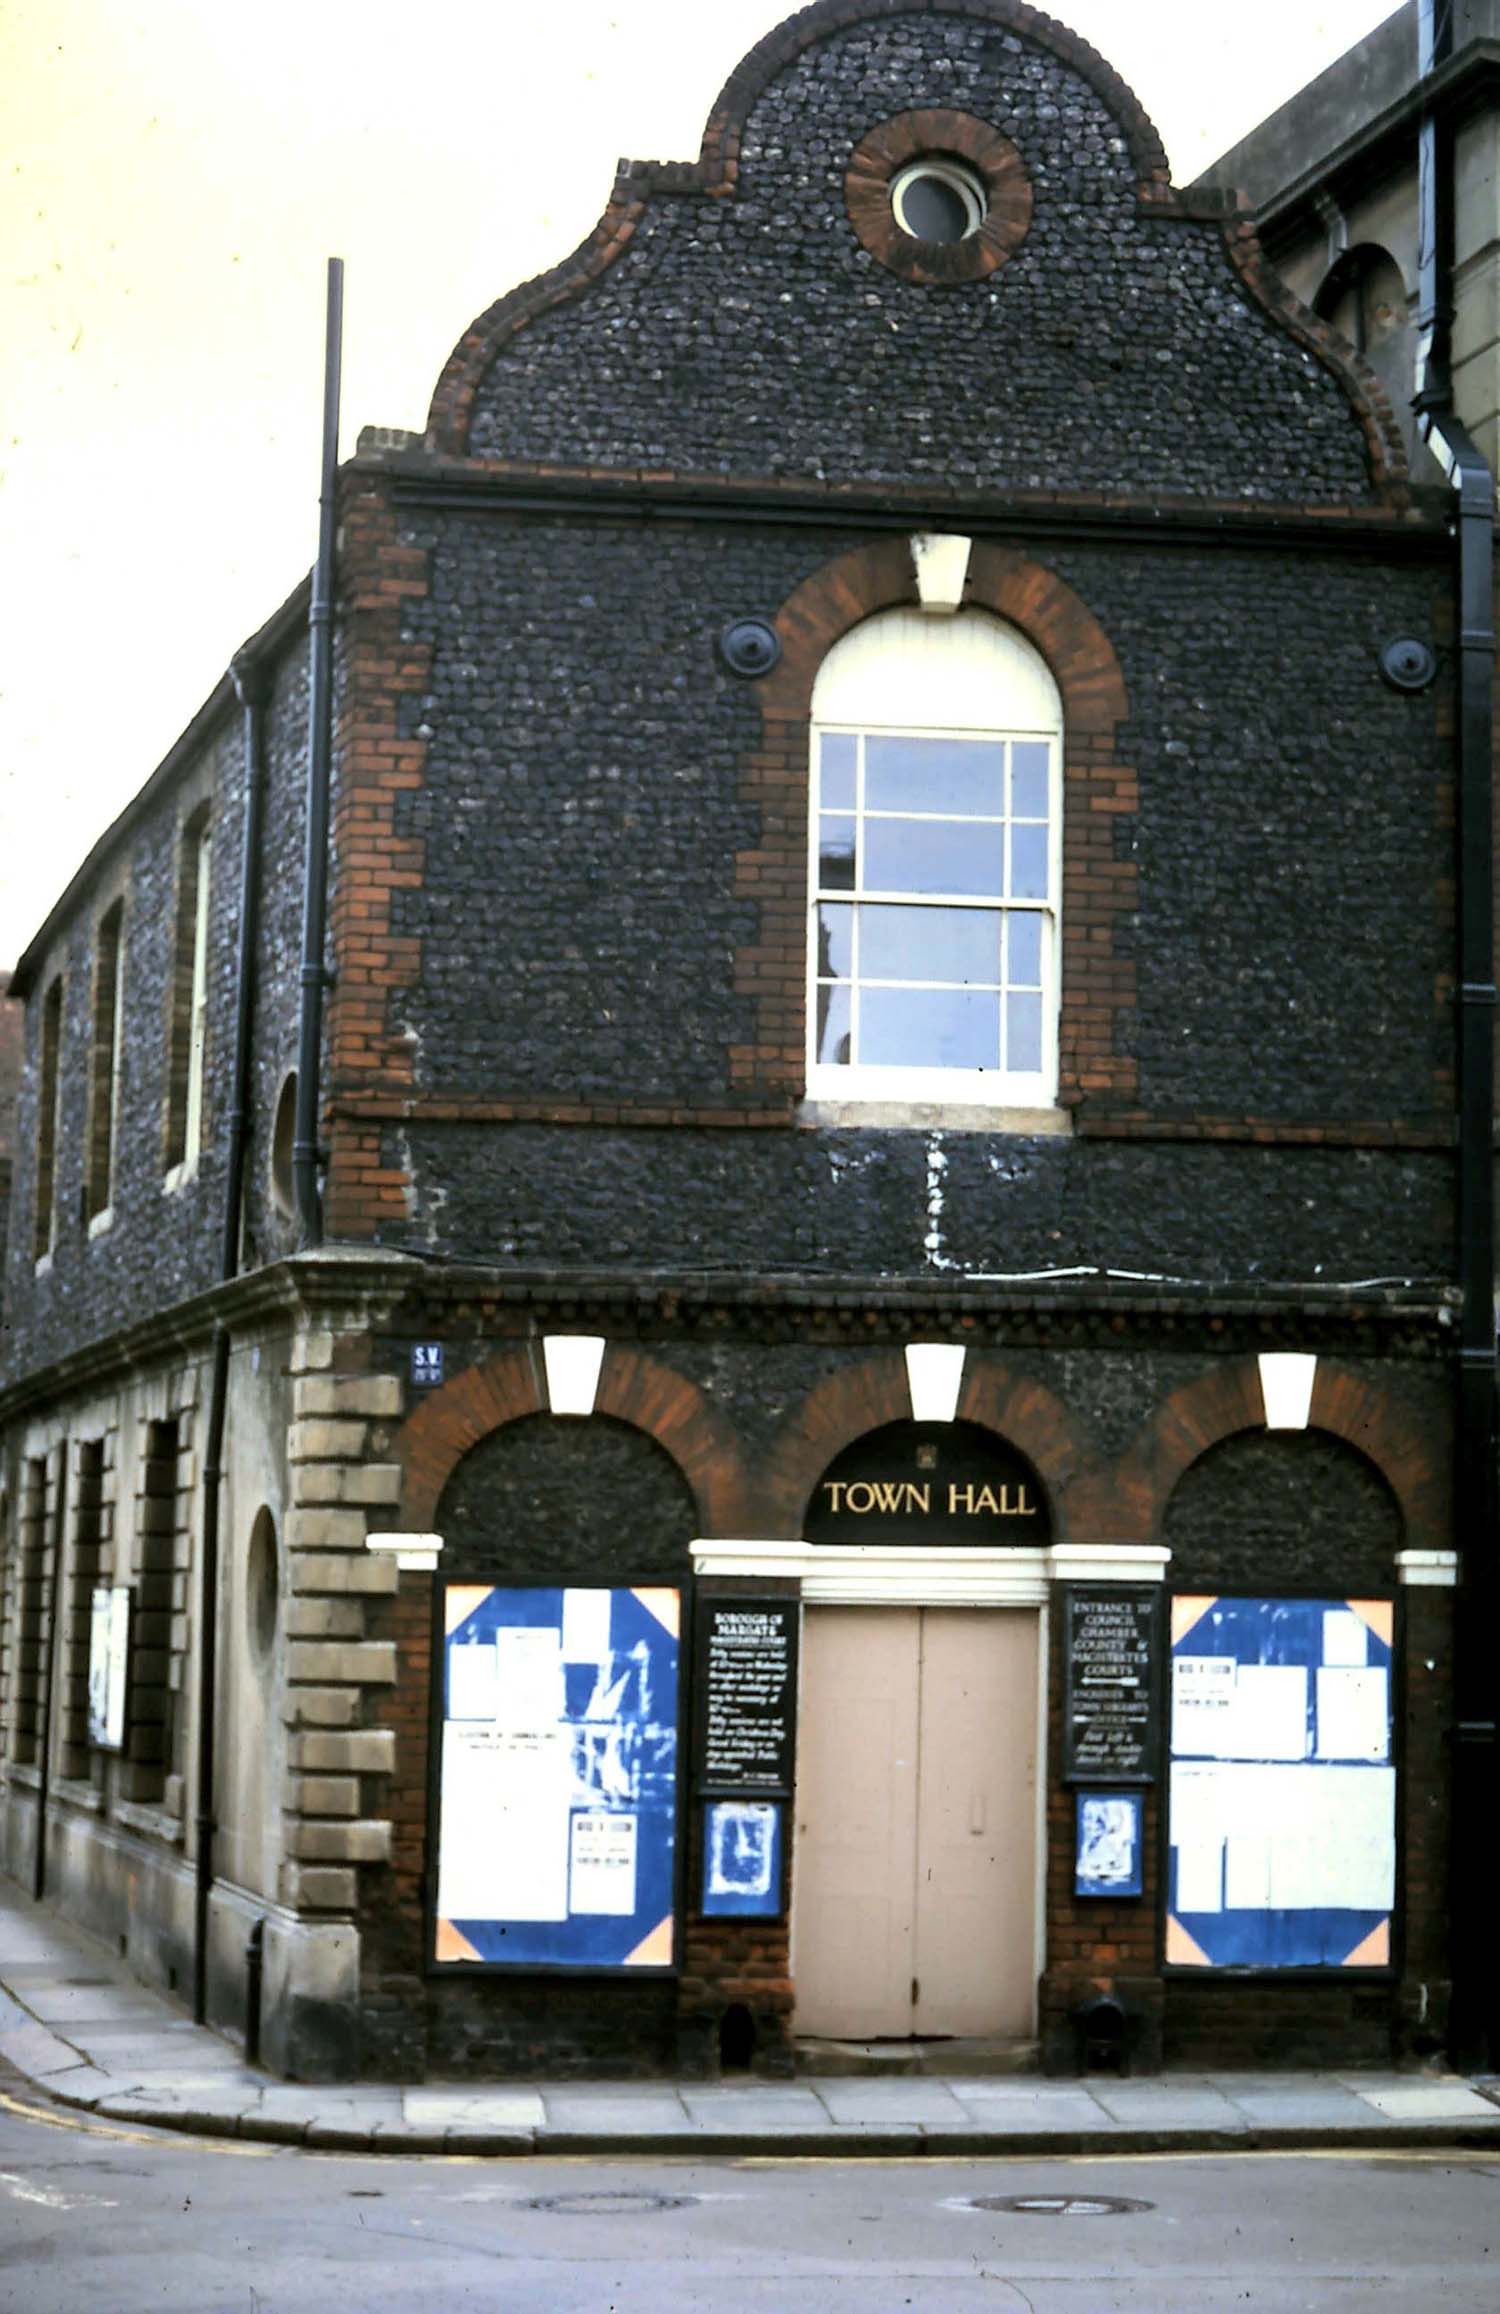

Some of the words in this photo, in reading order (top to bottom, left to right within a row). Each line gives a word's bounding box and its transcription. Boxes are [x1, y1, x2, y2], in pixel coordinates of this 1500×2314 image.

[824, 1481, 930, 1515] TOWN
[949, 1483, 1038, 1516] HALL
[1073, 1602, 1132, 1615] ENTRANCE
[1136, 1603, 1152, 1614] TO
[715, 1612, 768, 1625] BOROUGH
[769, 1613, 784, 1626] OF
[1084, 1614, 1135, 1626] COUNCIL
[718, 1624, 777, 1636] MARGATE
[1081, 1627, 1139, 1639] CHAMBER
